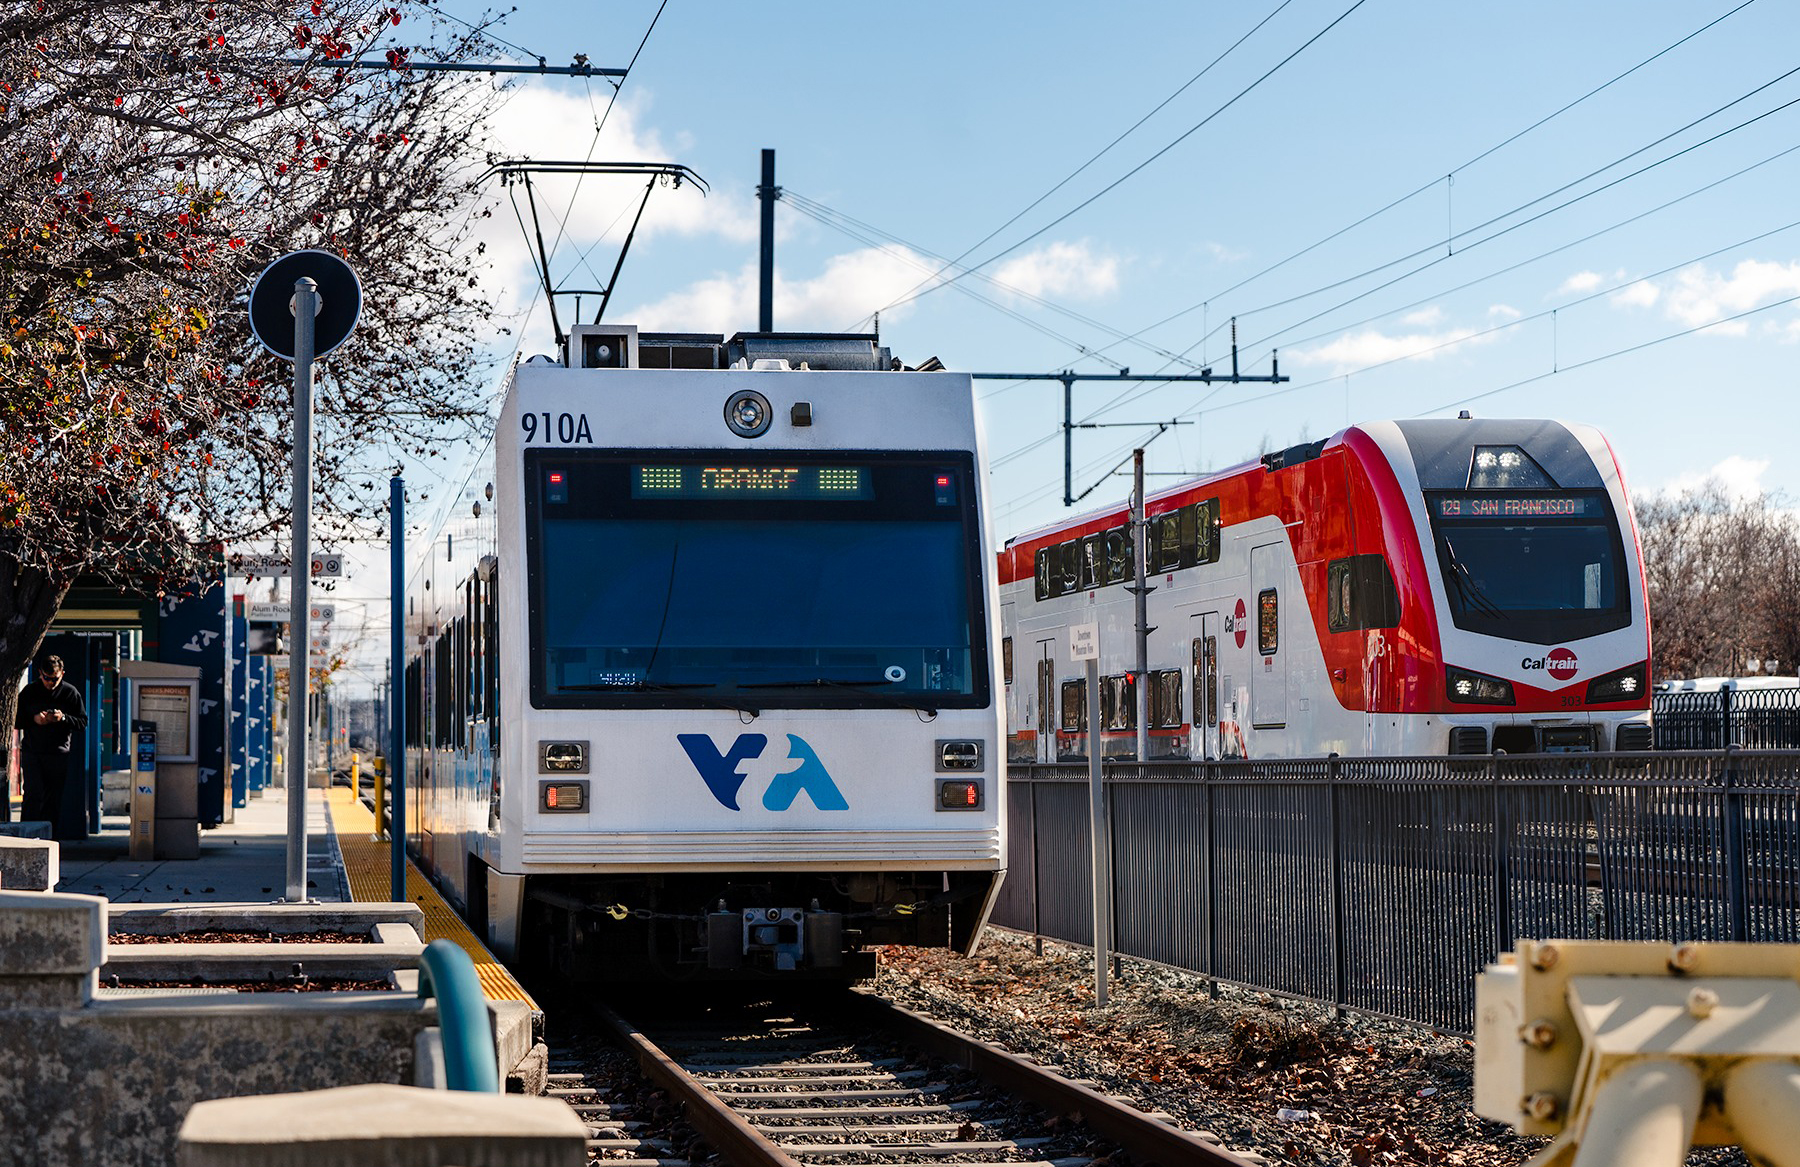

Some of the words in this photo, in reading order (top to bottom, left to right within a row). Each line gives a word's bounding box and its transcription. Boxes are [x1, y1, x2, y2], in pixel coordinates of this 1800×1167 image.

[521, 412, 593, 443] 910A
[1441, 500, 1460, 515] 129
[1472, 500, 1499, 515] SAN
[1505, 499, 1575, 515] FRANCISCO
[251, 605, 271, 613] Alum
[273, 605, 291, 613] Rock
[1521, 656, 1580, 670] Caltrain
[1561, 695, 1582, 707] 303
